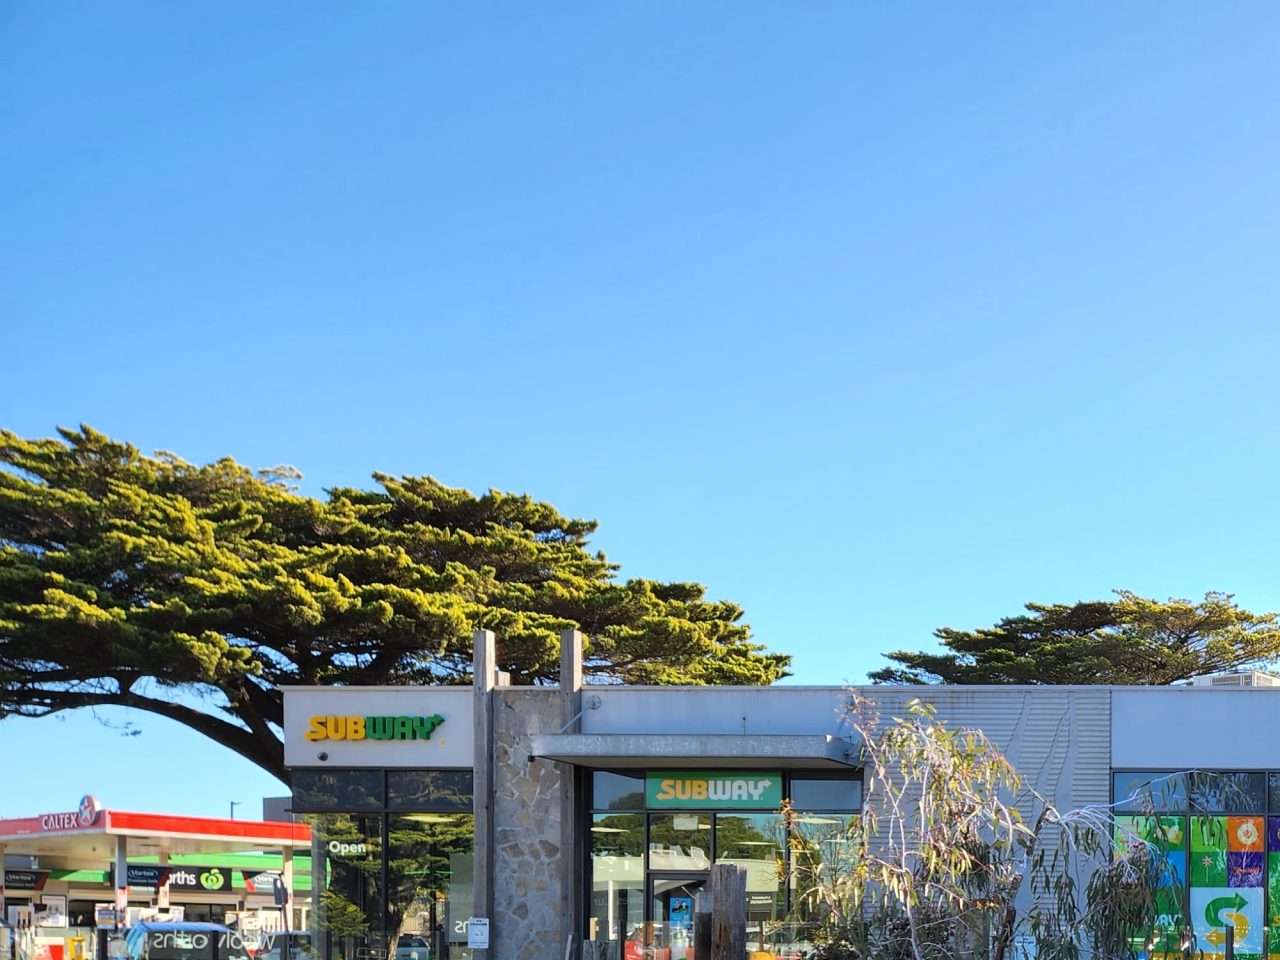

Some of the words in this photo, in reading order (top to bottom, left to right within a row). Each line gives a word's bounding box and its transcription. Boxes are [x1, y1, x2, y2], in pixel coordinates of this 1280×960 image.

[304, 713, 446, 742] SUBWAY
[656, 778, 772, 801] SUBWAY
[42, 813, 79, 831] CALTEX
[328, 840, 367, 856] Open
[168, 870, 197, 886] orths
